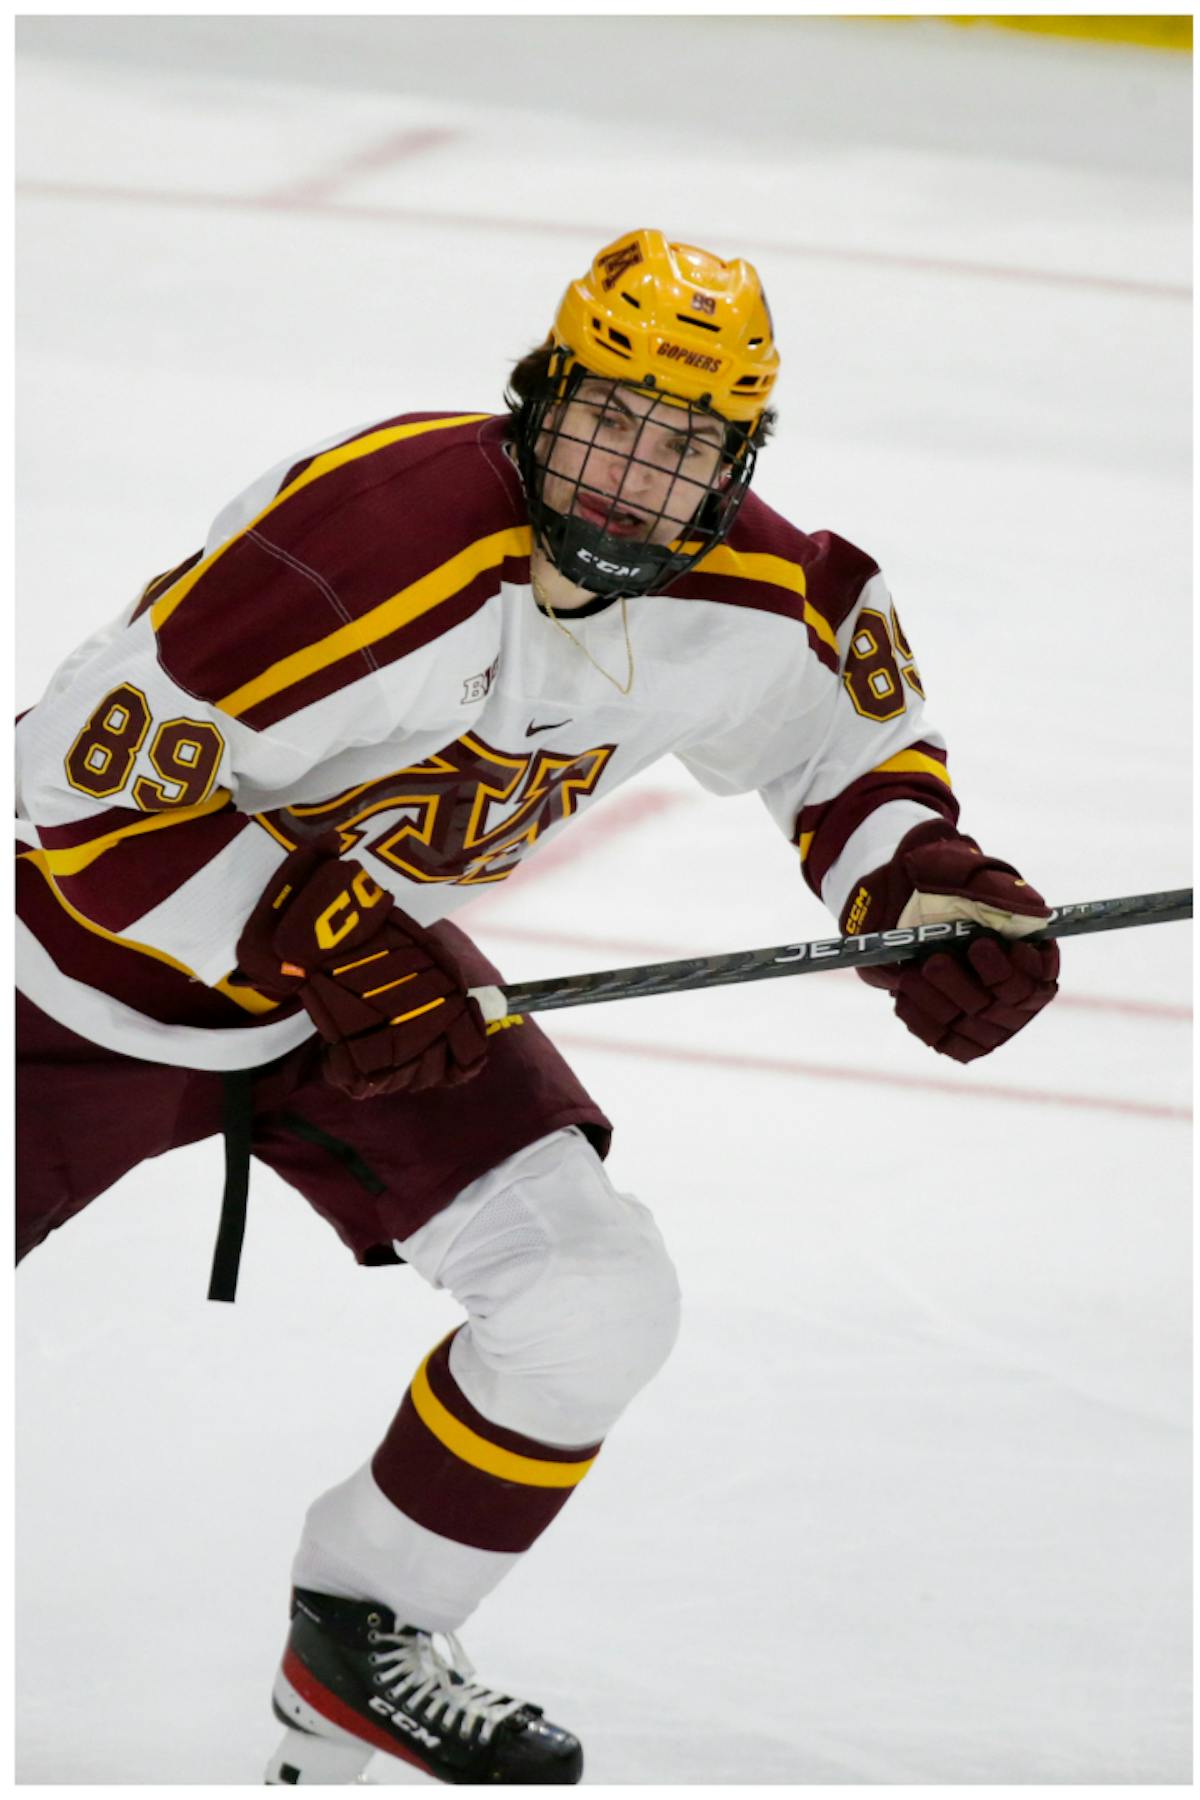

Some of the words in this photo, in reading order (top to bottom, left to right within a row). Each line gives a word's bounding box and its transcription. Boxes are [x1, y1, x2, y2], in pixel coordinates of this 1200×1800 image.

[656, 341, 723, 375] GOPHERS
[576, 547, 642, 578] CCM
[64, 682, 224, 812] 89
[368, 1696, 441, 1748] CCM
